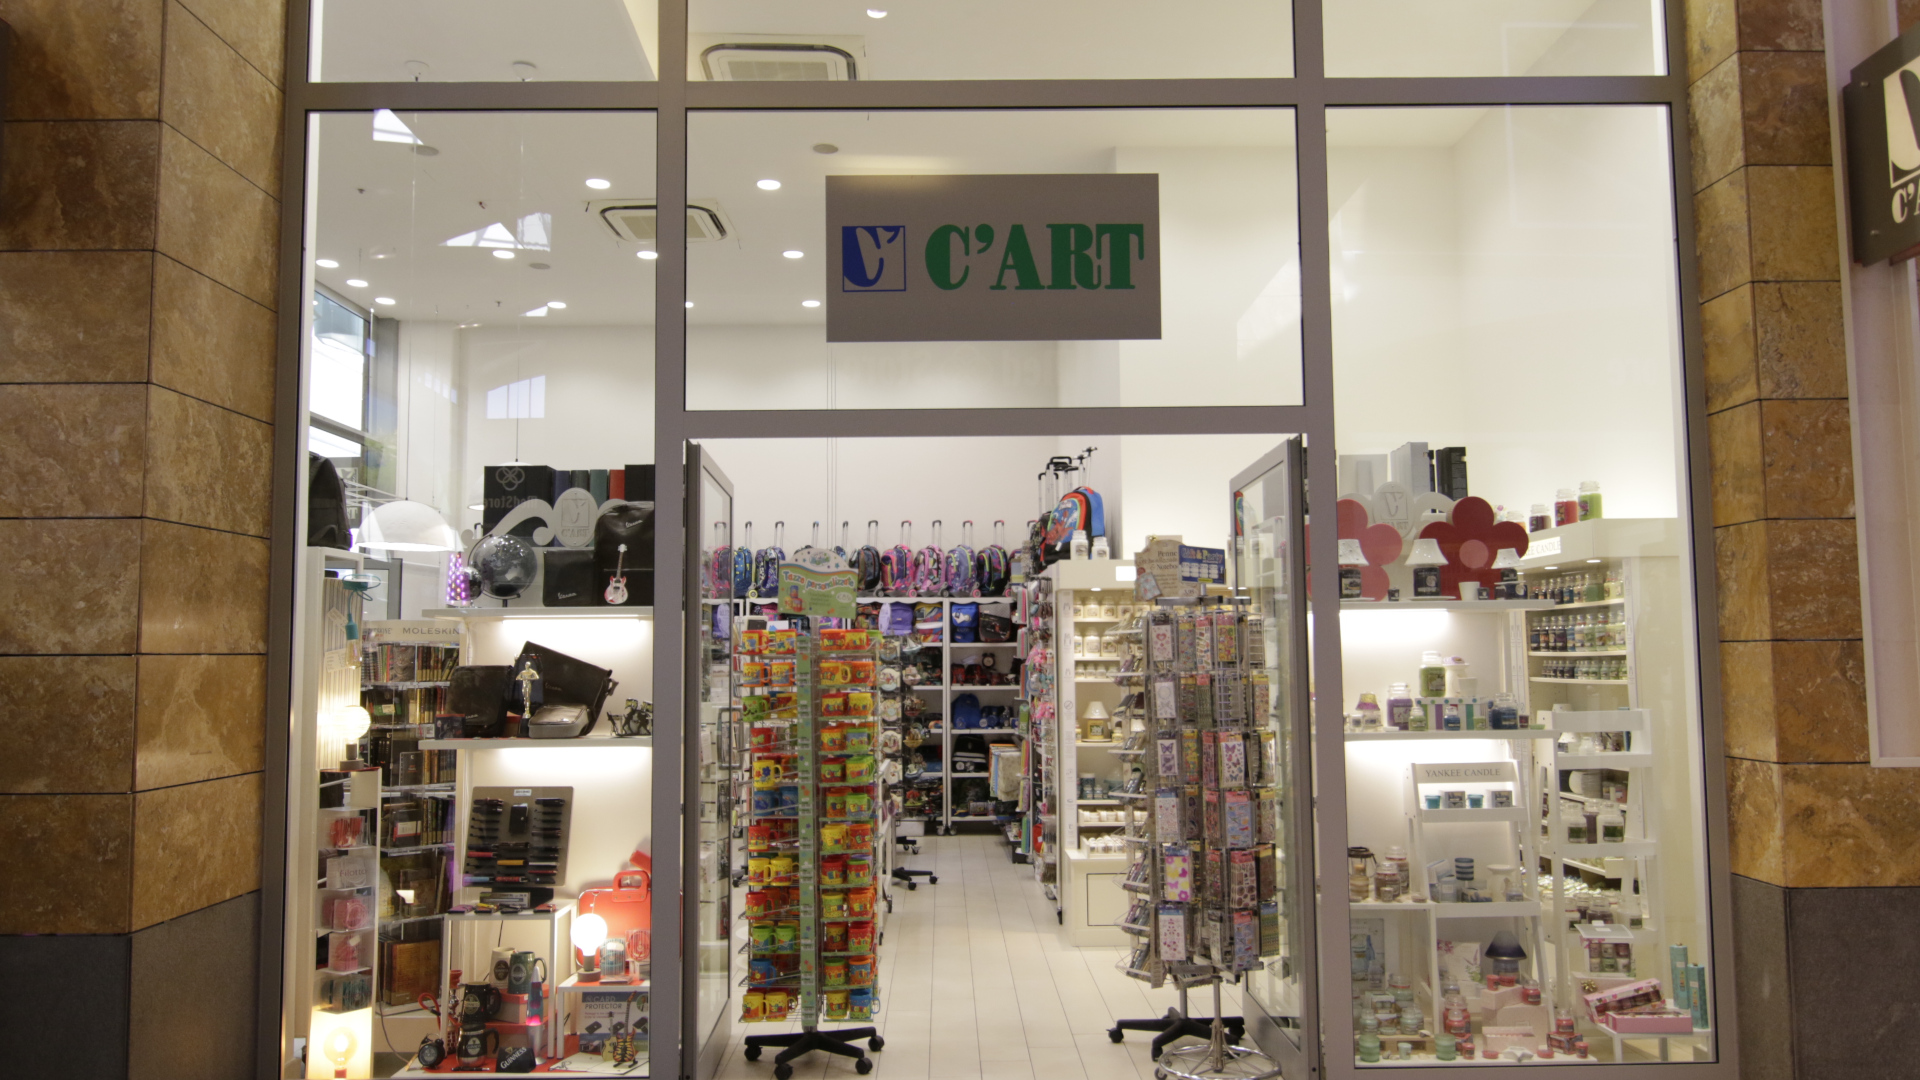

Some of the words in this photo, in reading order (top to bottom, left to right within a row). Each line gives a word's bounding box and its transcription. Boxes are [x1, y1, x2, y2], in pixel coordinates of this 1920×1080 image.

[924, 223, 1144, 291] C'ART
[402, 627, 459, 635] MOLESKIN
[1425, 769, 1461, 777] YANKEE
[1464, 768, 1500, 776] CANDLE
[500, 1046, 527, 1069] GUINNESS
